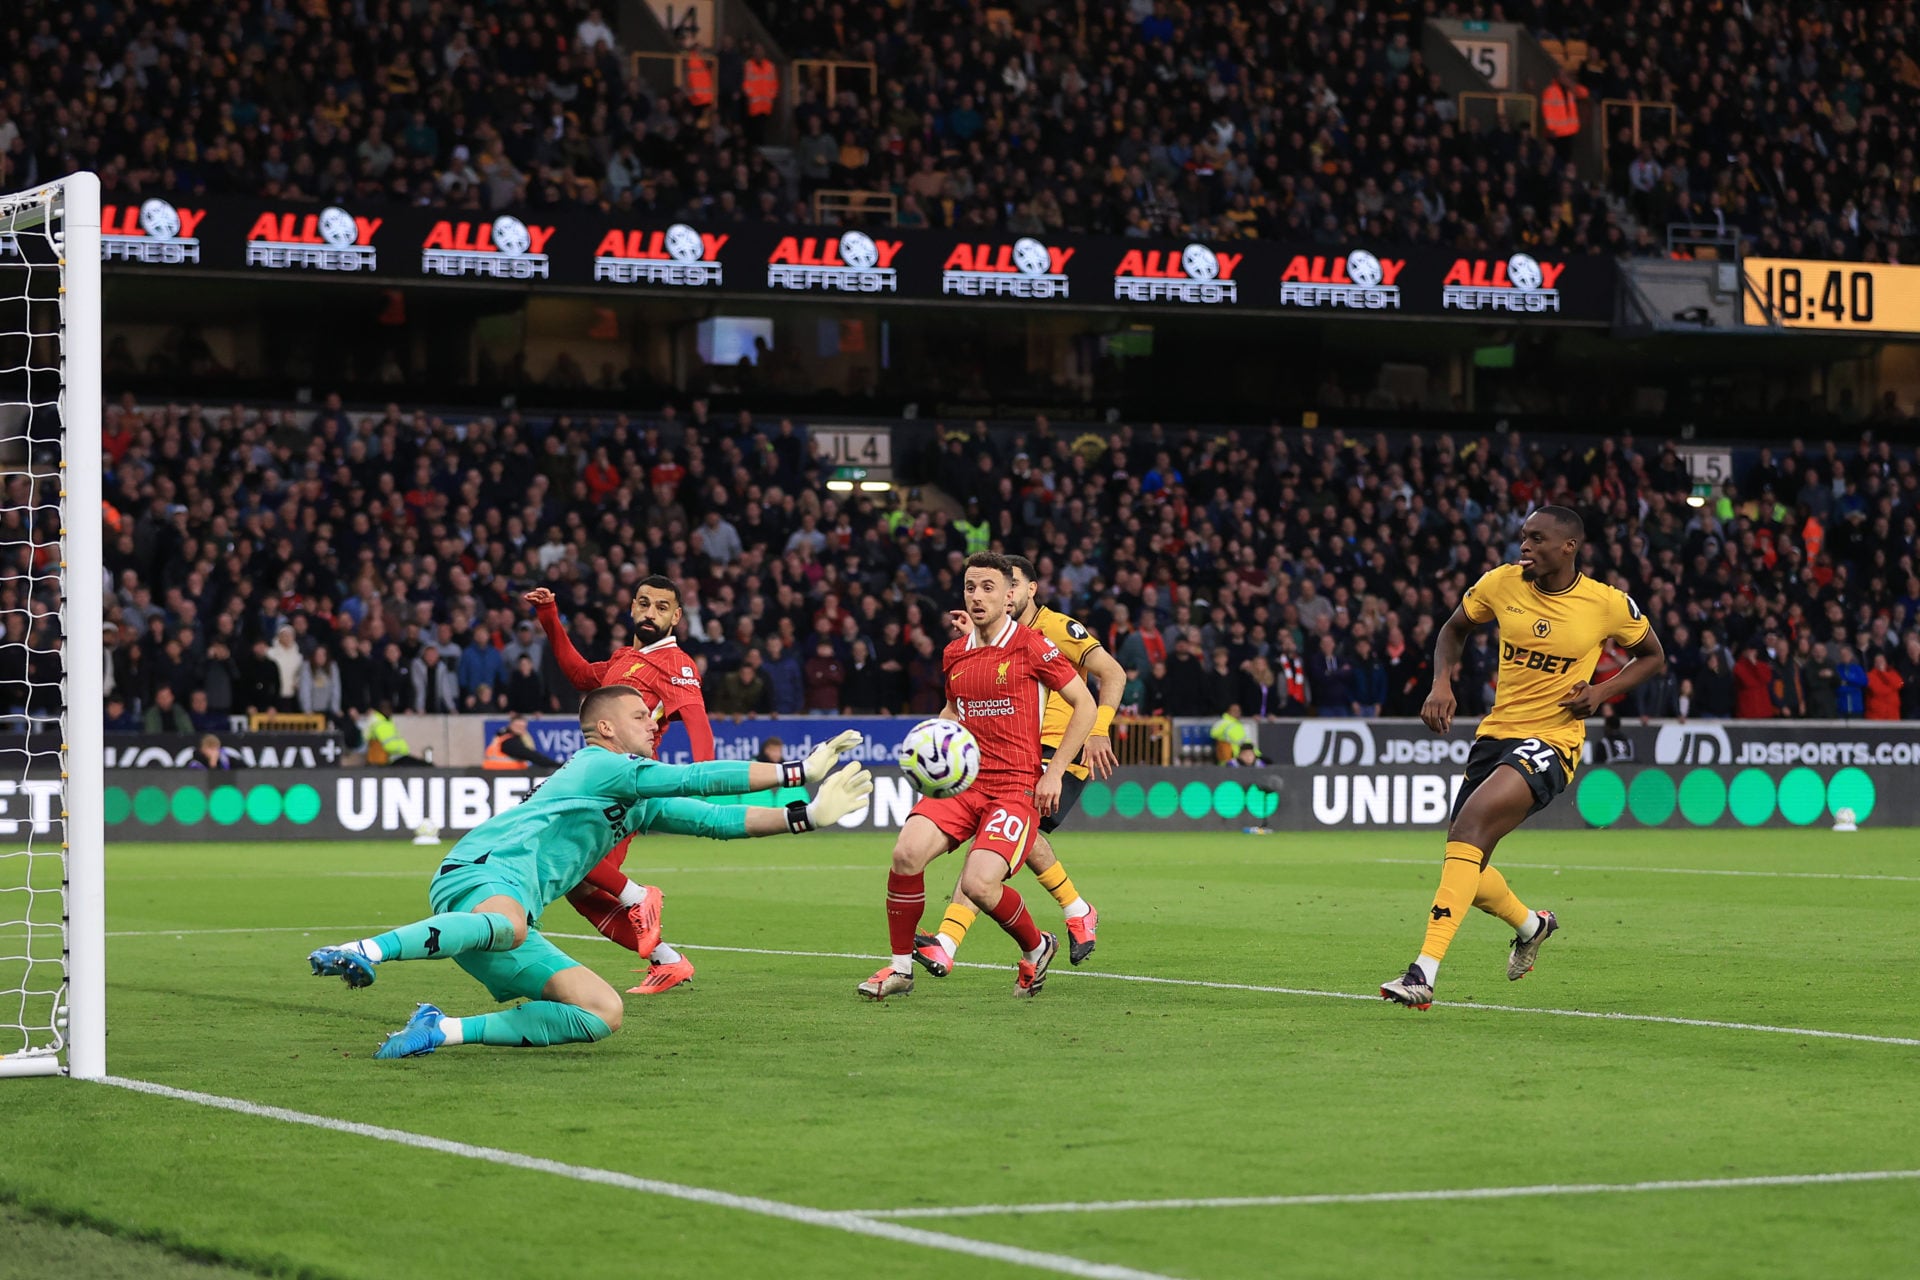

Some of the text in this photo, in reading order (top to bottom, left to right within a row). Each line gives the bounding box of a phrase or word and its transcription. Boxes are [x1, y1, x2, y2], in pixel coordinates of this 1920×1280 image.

[246, 248, 376, 271] REFRESH
[422, 256, 549, 279] REFRESH
[594, 263, 723, 286] REFRESH
[768, 270, 897, 292] REFRESH
[943, 277, 1069, 298] REFRESH
[1114, 283, 1238, 304] REFRESH
[1280, 288, 1401, 309] REFRESH
[1766, 267, 1874, 322] 18:40
[1443, 290, 1560, 312] REFRESH
[1502, 641, 1578, 675] DEBET
[967, 697, 1011, 709] standard
[967, 706, 1015, 717] chartered
[1512, 738, 1556, 774] 24
[336, 777, 548, 831] UNIBE
[985, 808, 1024, 842] 20
